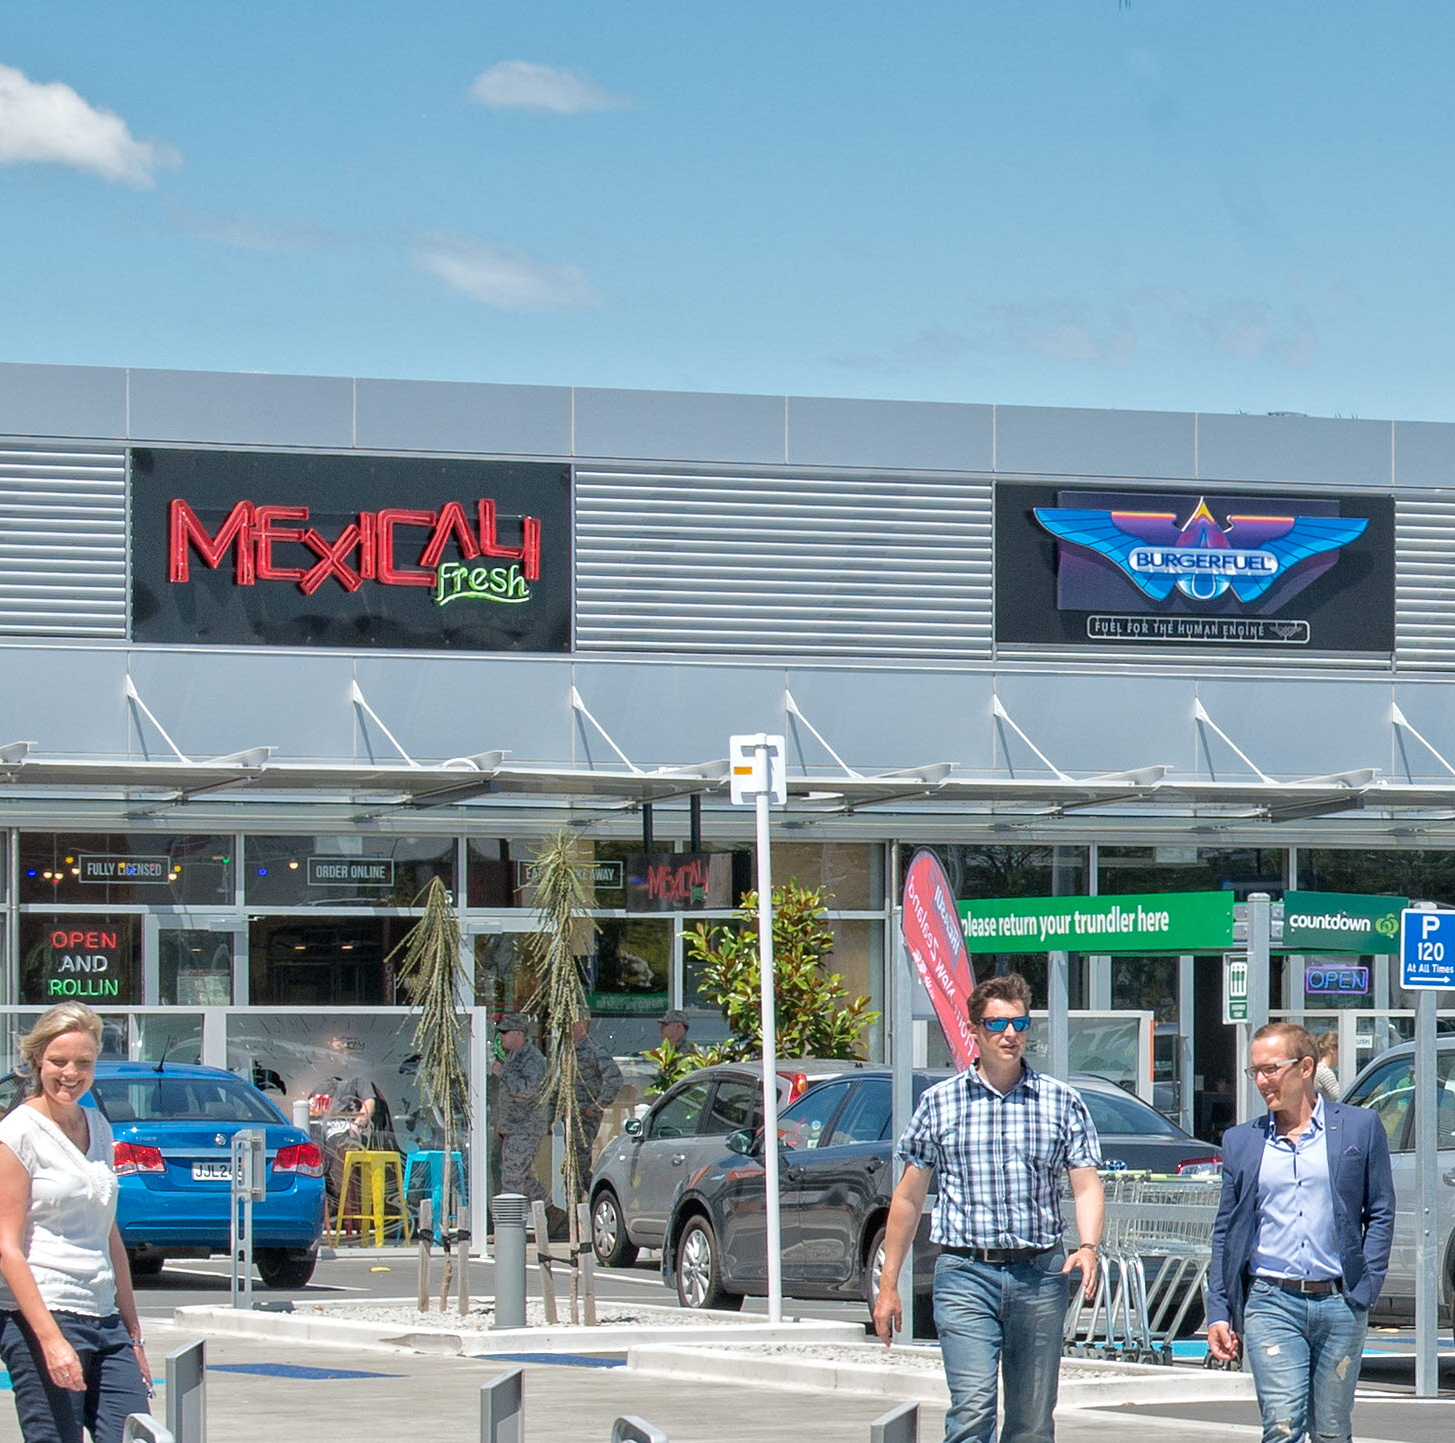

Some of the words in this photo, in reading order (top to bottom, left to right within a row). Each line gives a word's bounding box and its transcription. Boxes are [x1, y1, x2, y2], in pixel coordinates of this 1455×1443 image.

[1136, 552, 1272, 572] BURGERFUEL
[1095, 621, 1122, 633] FUEL
[1127, 622, 1148, 634] FOR
[1153, 623, 1174, 635] THE
[1178, 624, 1219, 637] HUMAN
[1223, 625, 1265, 637] ENGINE
[87, 863, 115, 876] FULLY
[118, 863, 162, 878] LICENSED
[315, 865, 349, 879] ORDER
[351, 865, 386, 879] ONLINE
[589, 868, 615, 881] AWAY
[999, 912, 1037, 937] return
[1039, 914, 1071, 942] your
[1074, 905, 1135, 934] trundler
[1137, 904, 1169, 932] here
[1289, 912, 1371, 932] countdown
[1422, 915, 1440, 939] P
[51, 931, 116, 949] OPEN
[1417, 942, 1444, 961] 120
[58, 955, 108, 973] AND
[1407, 963, 1416, 973] At
[1418, 963, 1430, 973] All
[1432, 963, 1454, 974] Times
[48, 978, 120, 997] ROLLIN
[1309, 970, 1366, 989] OPEN
